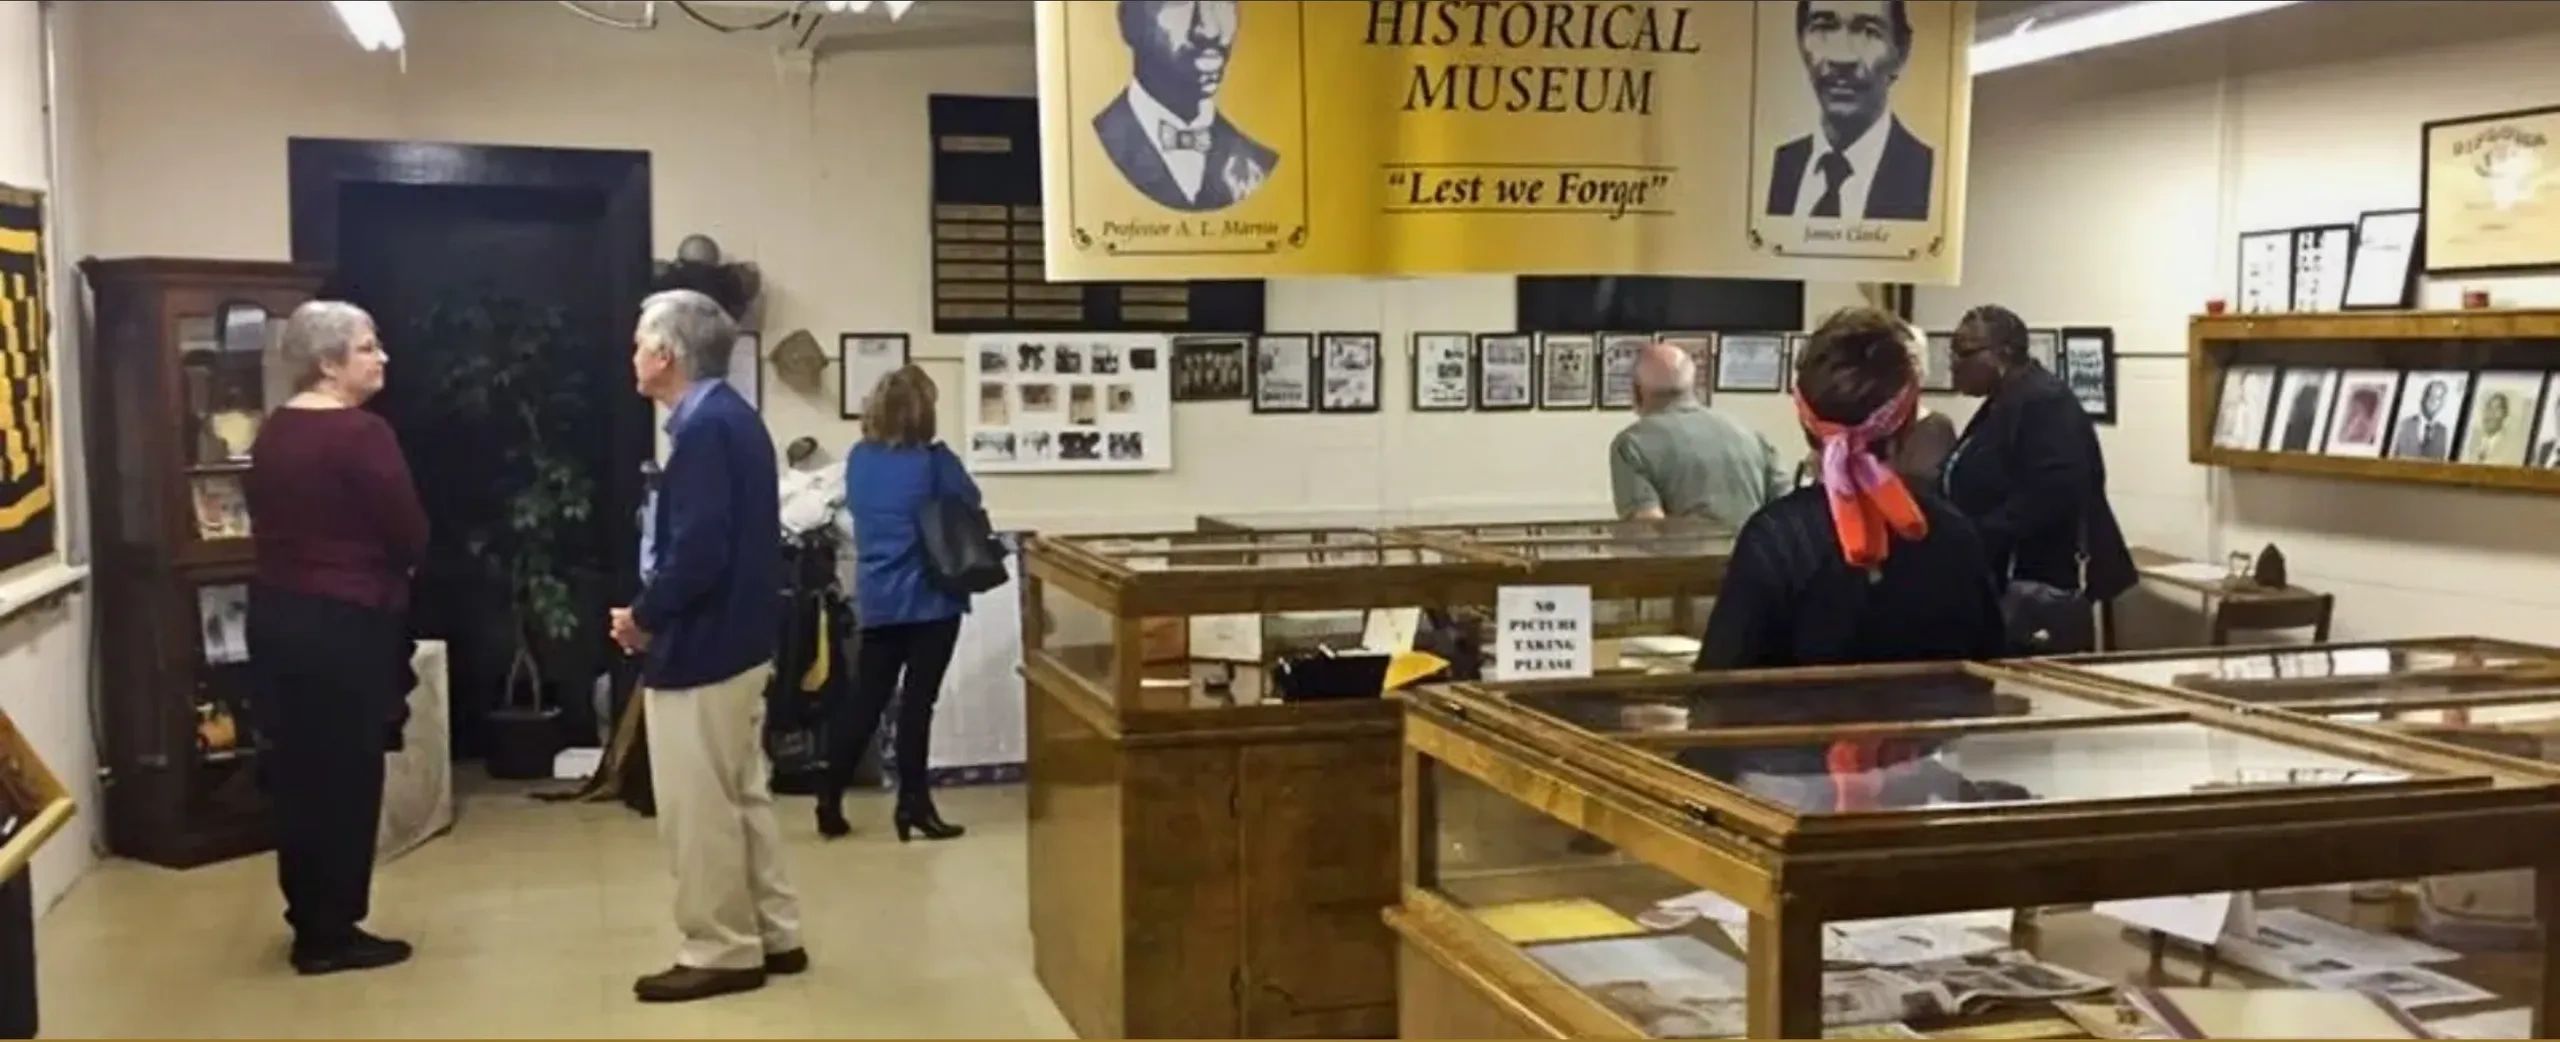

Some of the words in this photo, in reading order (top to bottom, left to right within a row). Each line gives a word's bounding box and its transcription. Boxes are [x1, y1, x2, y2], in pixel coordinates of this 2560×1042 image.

[1364, 0, 1701, 54] HISTORICAL
[1402, 63, 1654, 115] MUSEUM
[1496, 176, 1544, 204] we
[1102, 220, 1172, 241] Professor
[1535, 601, 1557, 612] NO
[1509, 620, 1578, 632] PICTURE
[1513, 640, 1576, 652] TAKING
[1514, 660, 1573, 671] PLEASE
